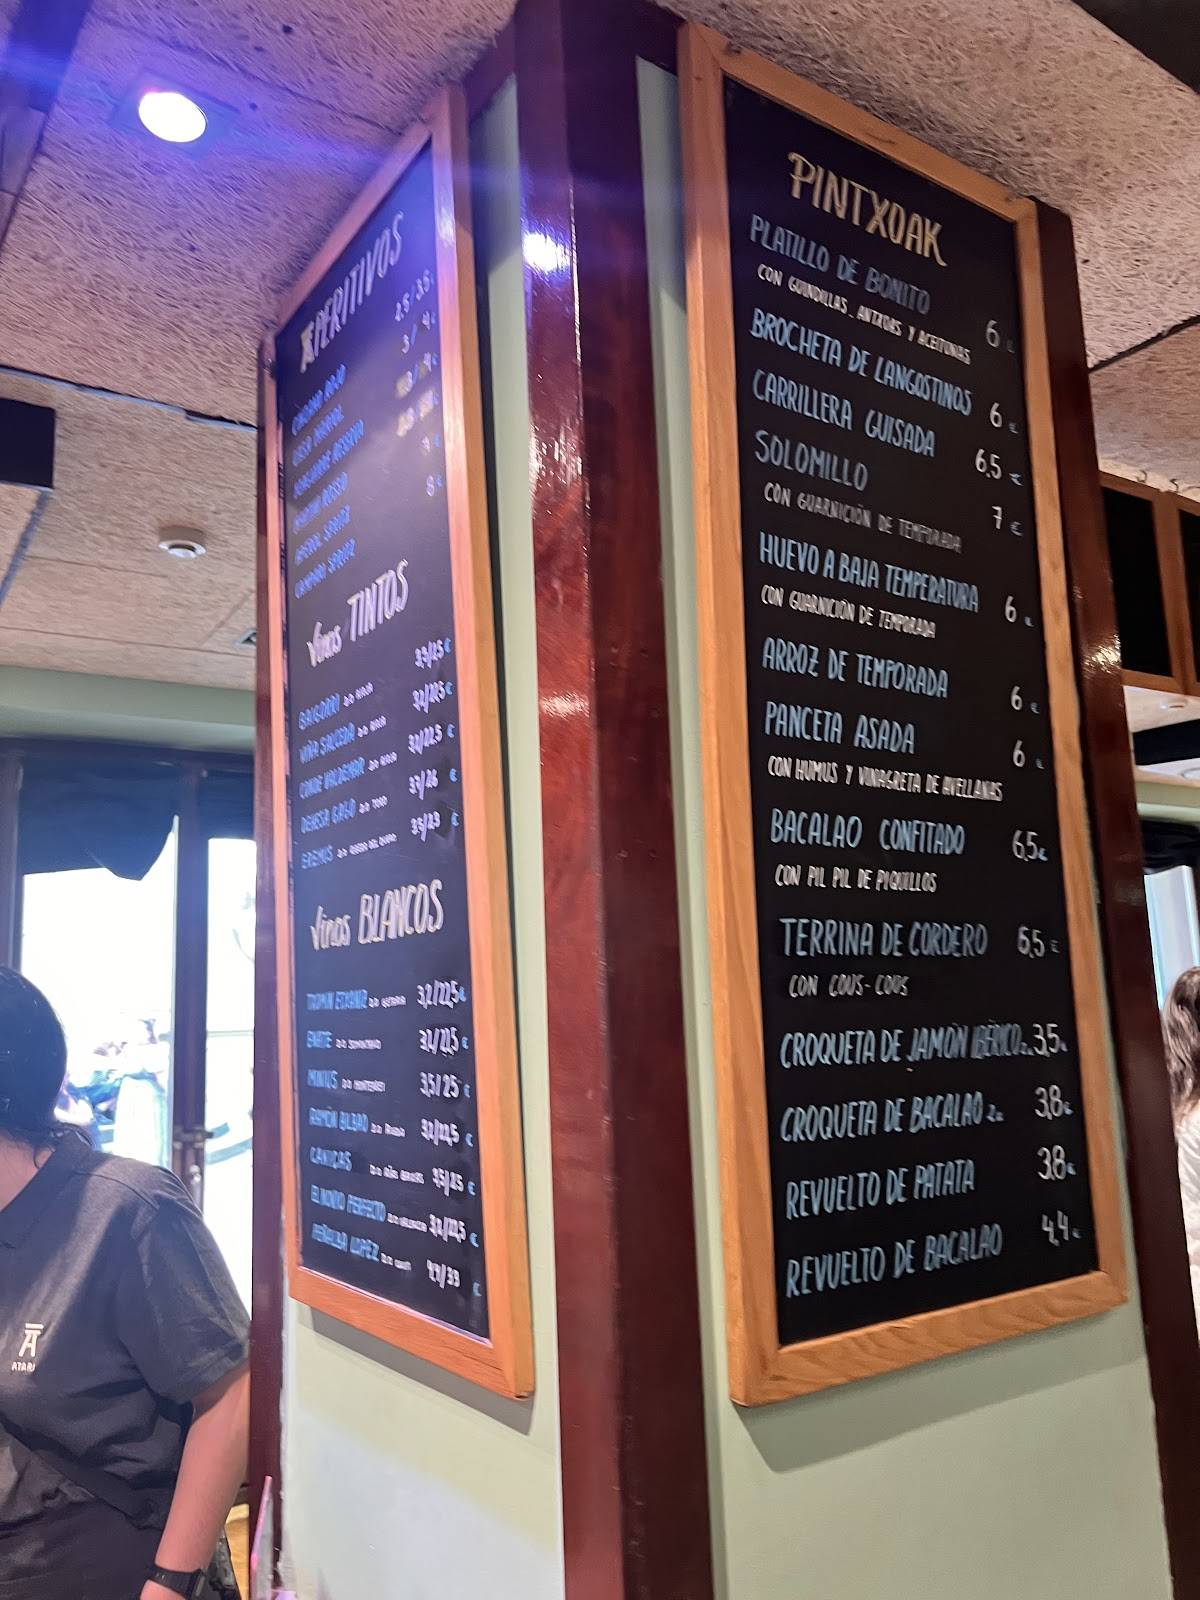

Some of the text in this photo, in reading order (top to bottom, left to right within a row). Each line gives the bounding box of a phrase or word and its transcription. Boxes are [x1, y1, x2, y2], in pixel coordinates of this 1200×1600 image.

[788, 151, 948, 267] PINTXOAK
[750, 214, 1000, 347] PLATILLO DE BONITO 6
[757, 263, 783, 287] CON
[750, 307, 842, 367] BROCHETA
[848, 345, 871, 377] DE
[874, 356, 973, 416] LANGOSTINOS
[990, 402, 1002, 428] 6
[752, 368, 853, 431] CARRILLERA
[864, 408, 936, 457] GUISADA
[754, 429, 869, 493] SOLOMILLO
[991, 505, 1002, 530] 7
[764, 481, 791, 508] CON
[878, 513, 893, 535] DE
[347, 558, 409, 642] TINTOS
[759, 531, 820, 576] HUEVO
[823, 549, 835, 579] A
[838, 552, 880, 590] BAJA
[885, 563, 980, 613] TEMPERATURA
[1004, 595, 1017, 623] 6
[761, 584, 784, 608] CON
[858, 604, 874, 626] DE
[762, 637, 819, 678] ARROZ
[828, 647, 850, 682] DE
[856, 653, 948, 699] TEMPORADA
[1011, 685, 1023, 711] 6
[765, 701, 843, 745] PANCETA
[854, 714, 916, 754] ASADA
[1012, 739, 1025, 768] 6
[768, 755, 792, 777] CON
[795, 758, 838, 784] HUMUS
[925, 774, 939, 794] DE
[770, 808, 863, 848] BACALAO
[879, 818, 966, 856] CONFITADO
[774, 864, 938, 893] CON PIL PIL DE PIQUILLOS
[310, 879, 444, 951] Vinos BLANCOS
[779, 918, 874, 957] TERRINA
[881, 922, 904, 957] DE
[908, 921, 988, 958] CORDERO
[789, 974, 818, 998] CON
[780, 1029, 875, 1069] CROQUETA
[881, 1029, 904, 1063] DE
[906, 1022, 968, 1062] JAMÓN
[780, 1101, 877, 1142] CROQUETA
[884, 1098, 906, 1133] DE
[909, 1091, 984, 1134] BACALAO
[786, 1171, 881, 1220] REVUELTO
[886, 1168, 908, 1205] DE
[914, 1159, 975, 1200] PATATA
[786, 1246, 886, 1298] REVUELTO
[893, 1239, 916, 1279] DE
[924, 1223, 1002, 1272] BACALAO
